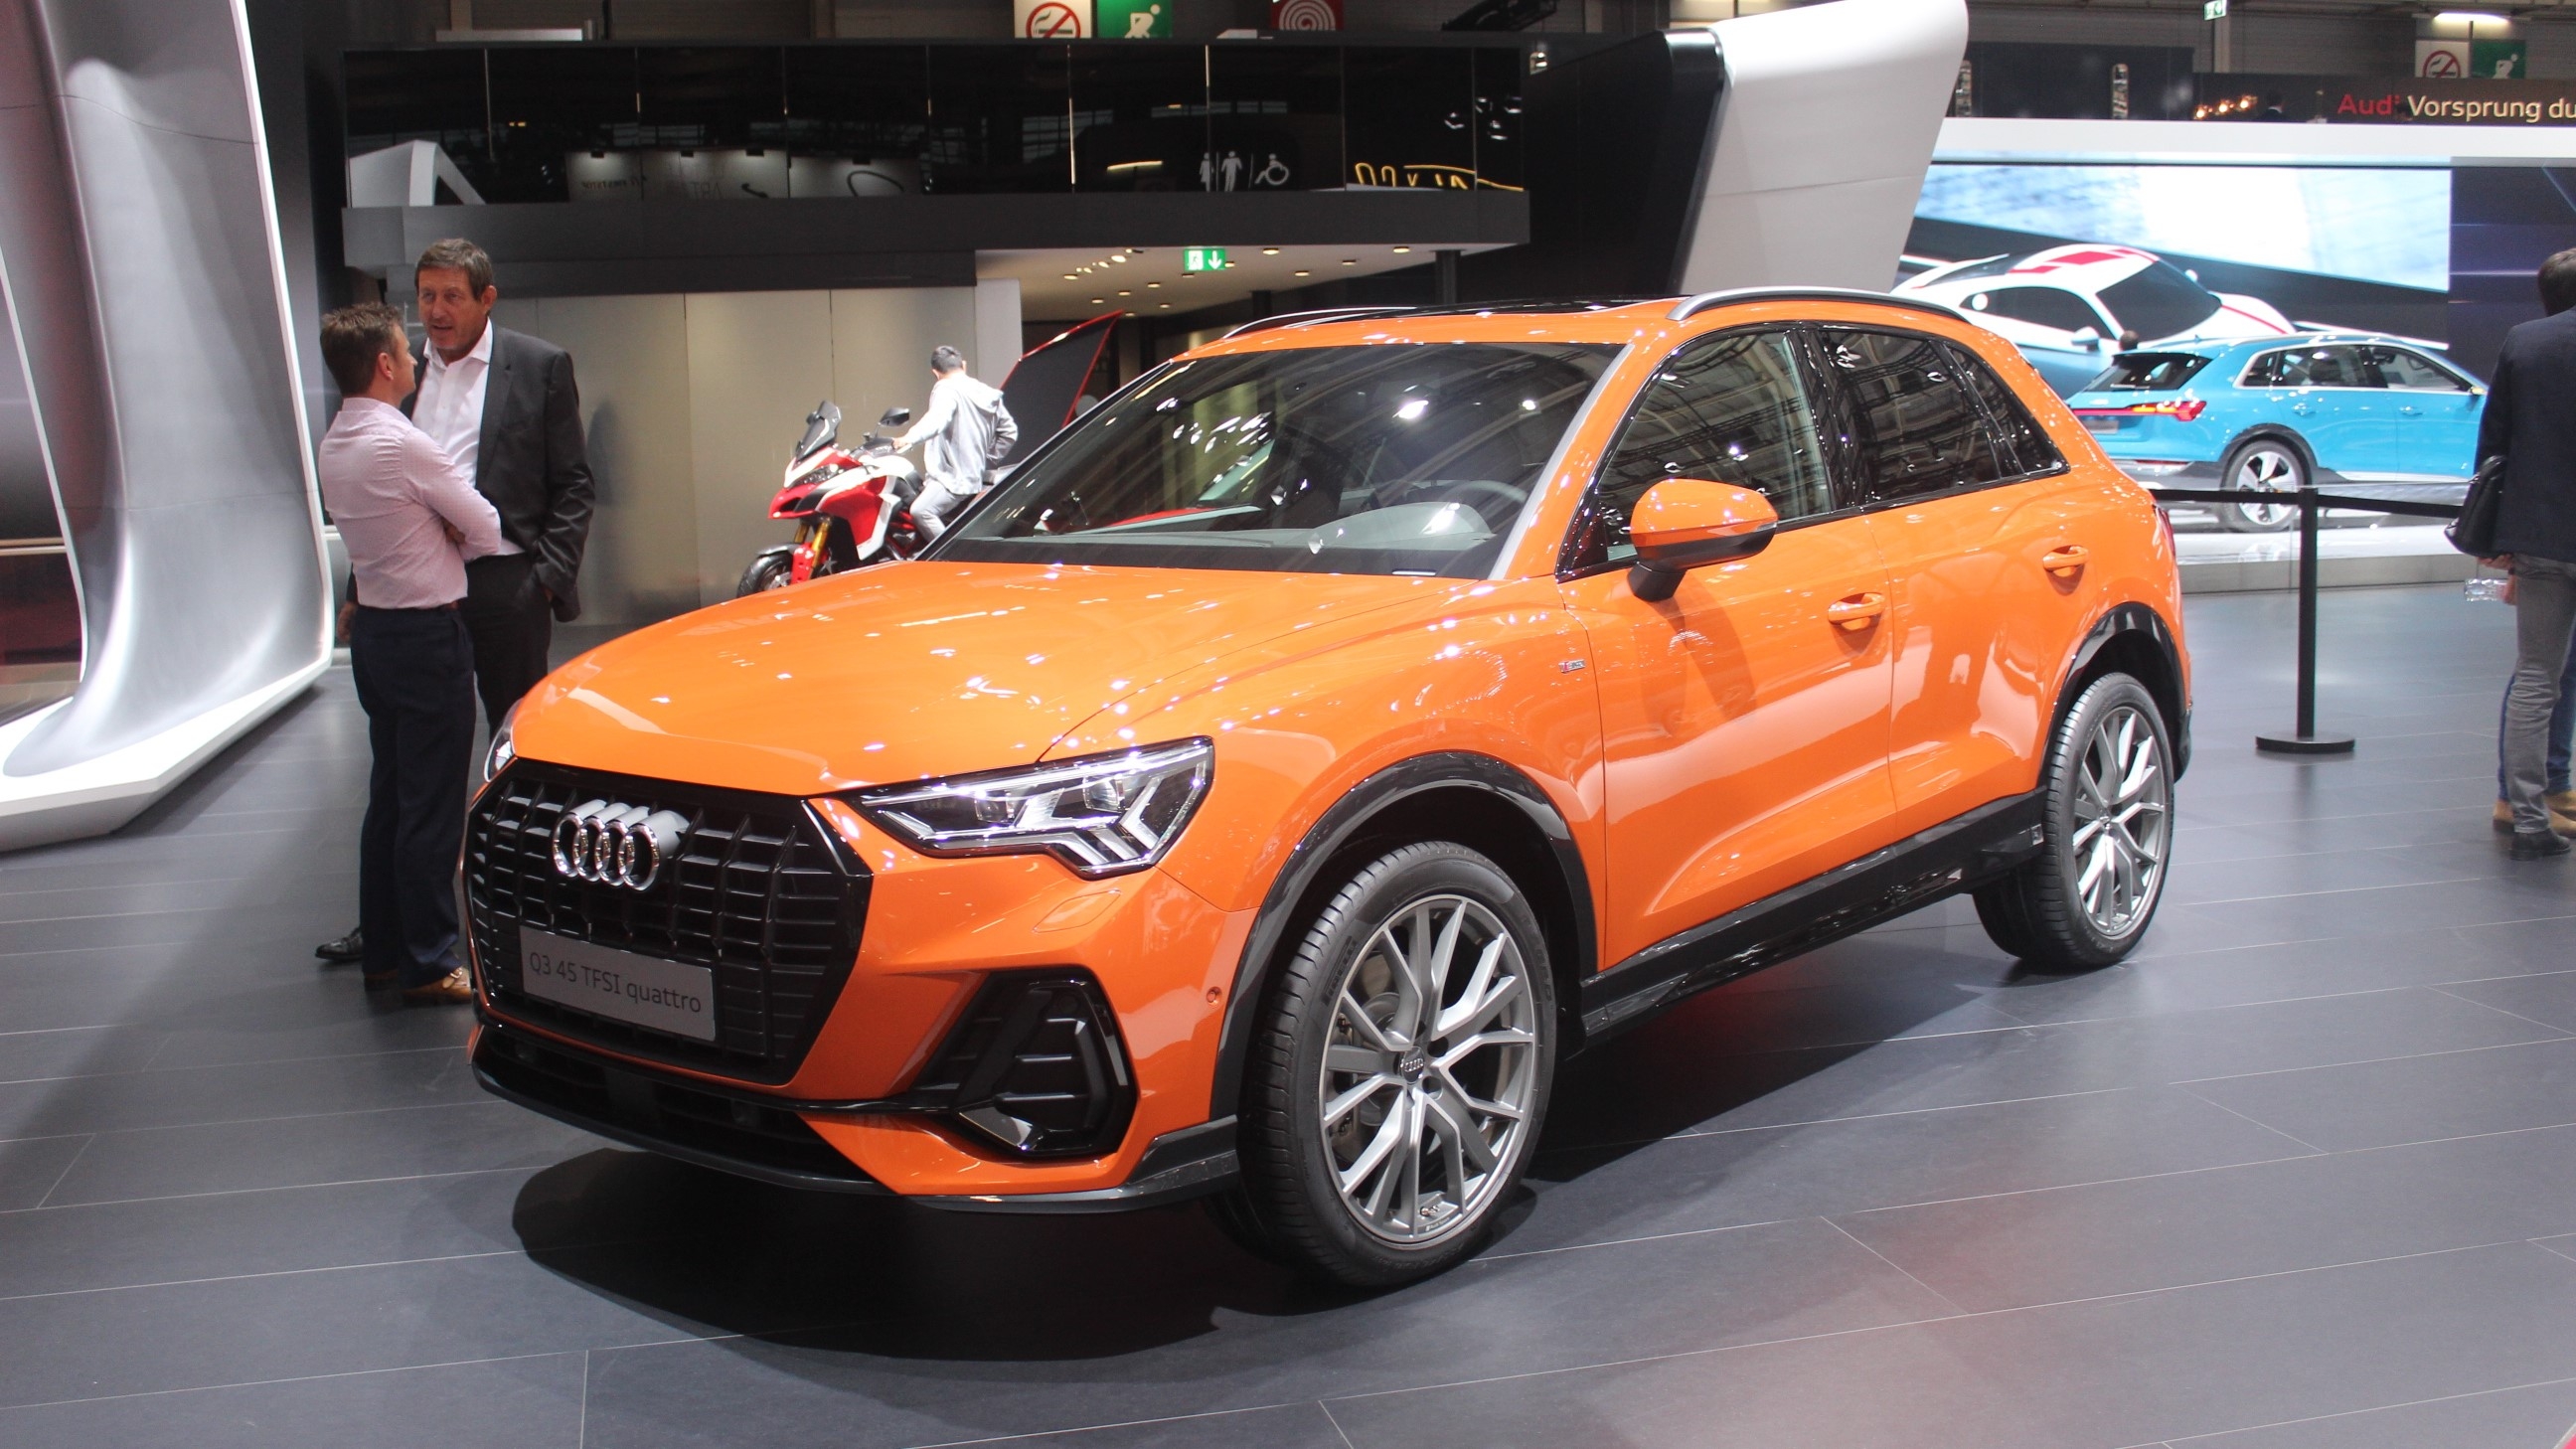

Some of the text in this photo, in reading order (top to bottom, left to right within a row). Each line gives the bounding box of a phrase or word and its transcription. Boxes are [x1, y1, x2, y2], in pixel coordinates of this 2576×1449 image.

[2407, 94, 2541, 123] Vorsprung
[2548, 97, 2576, 119] du
[530, 951, 702, 1013] Q3 45 TFSI quattro
